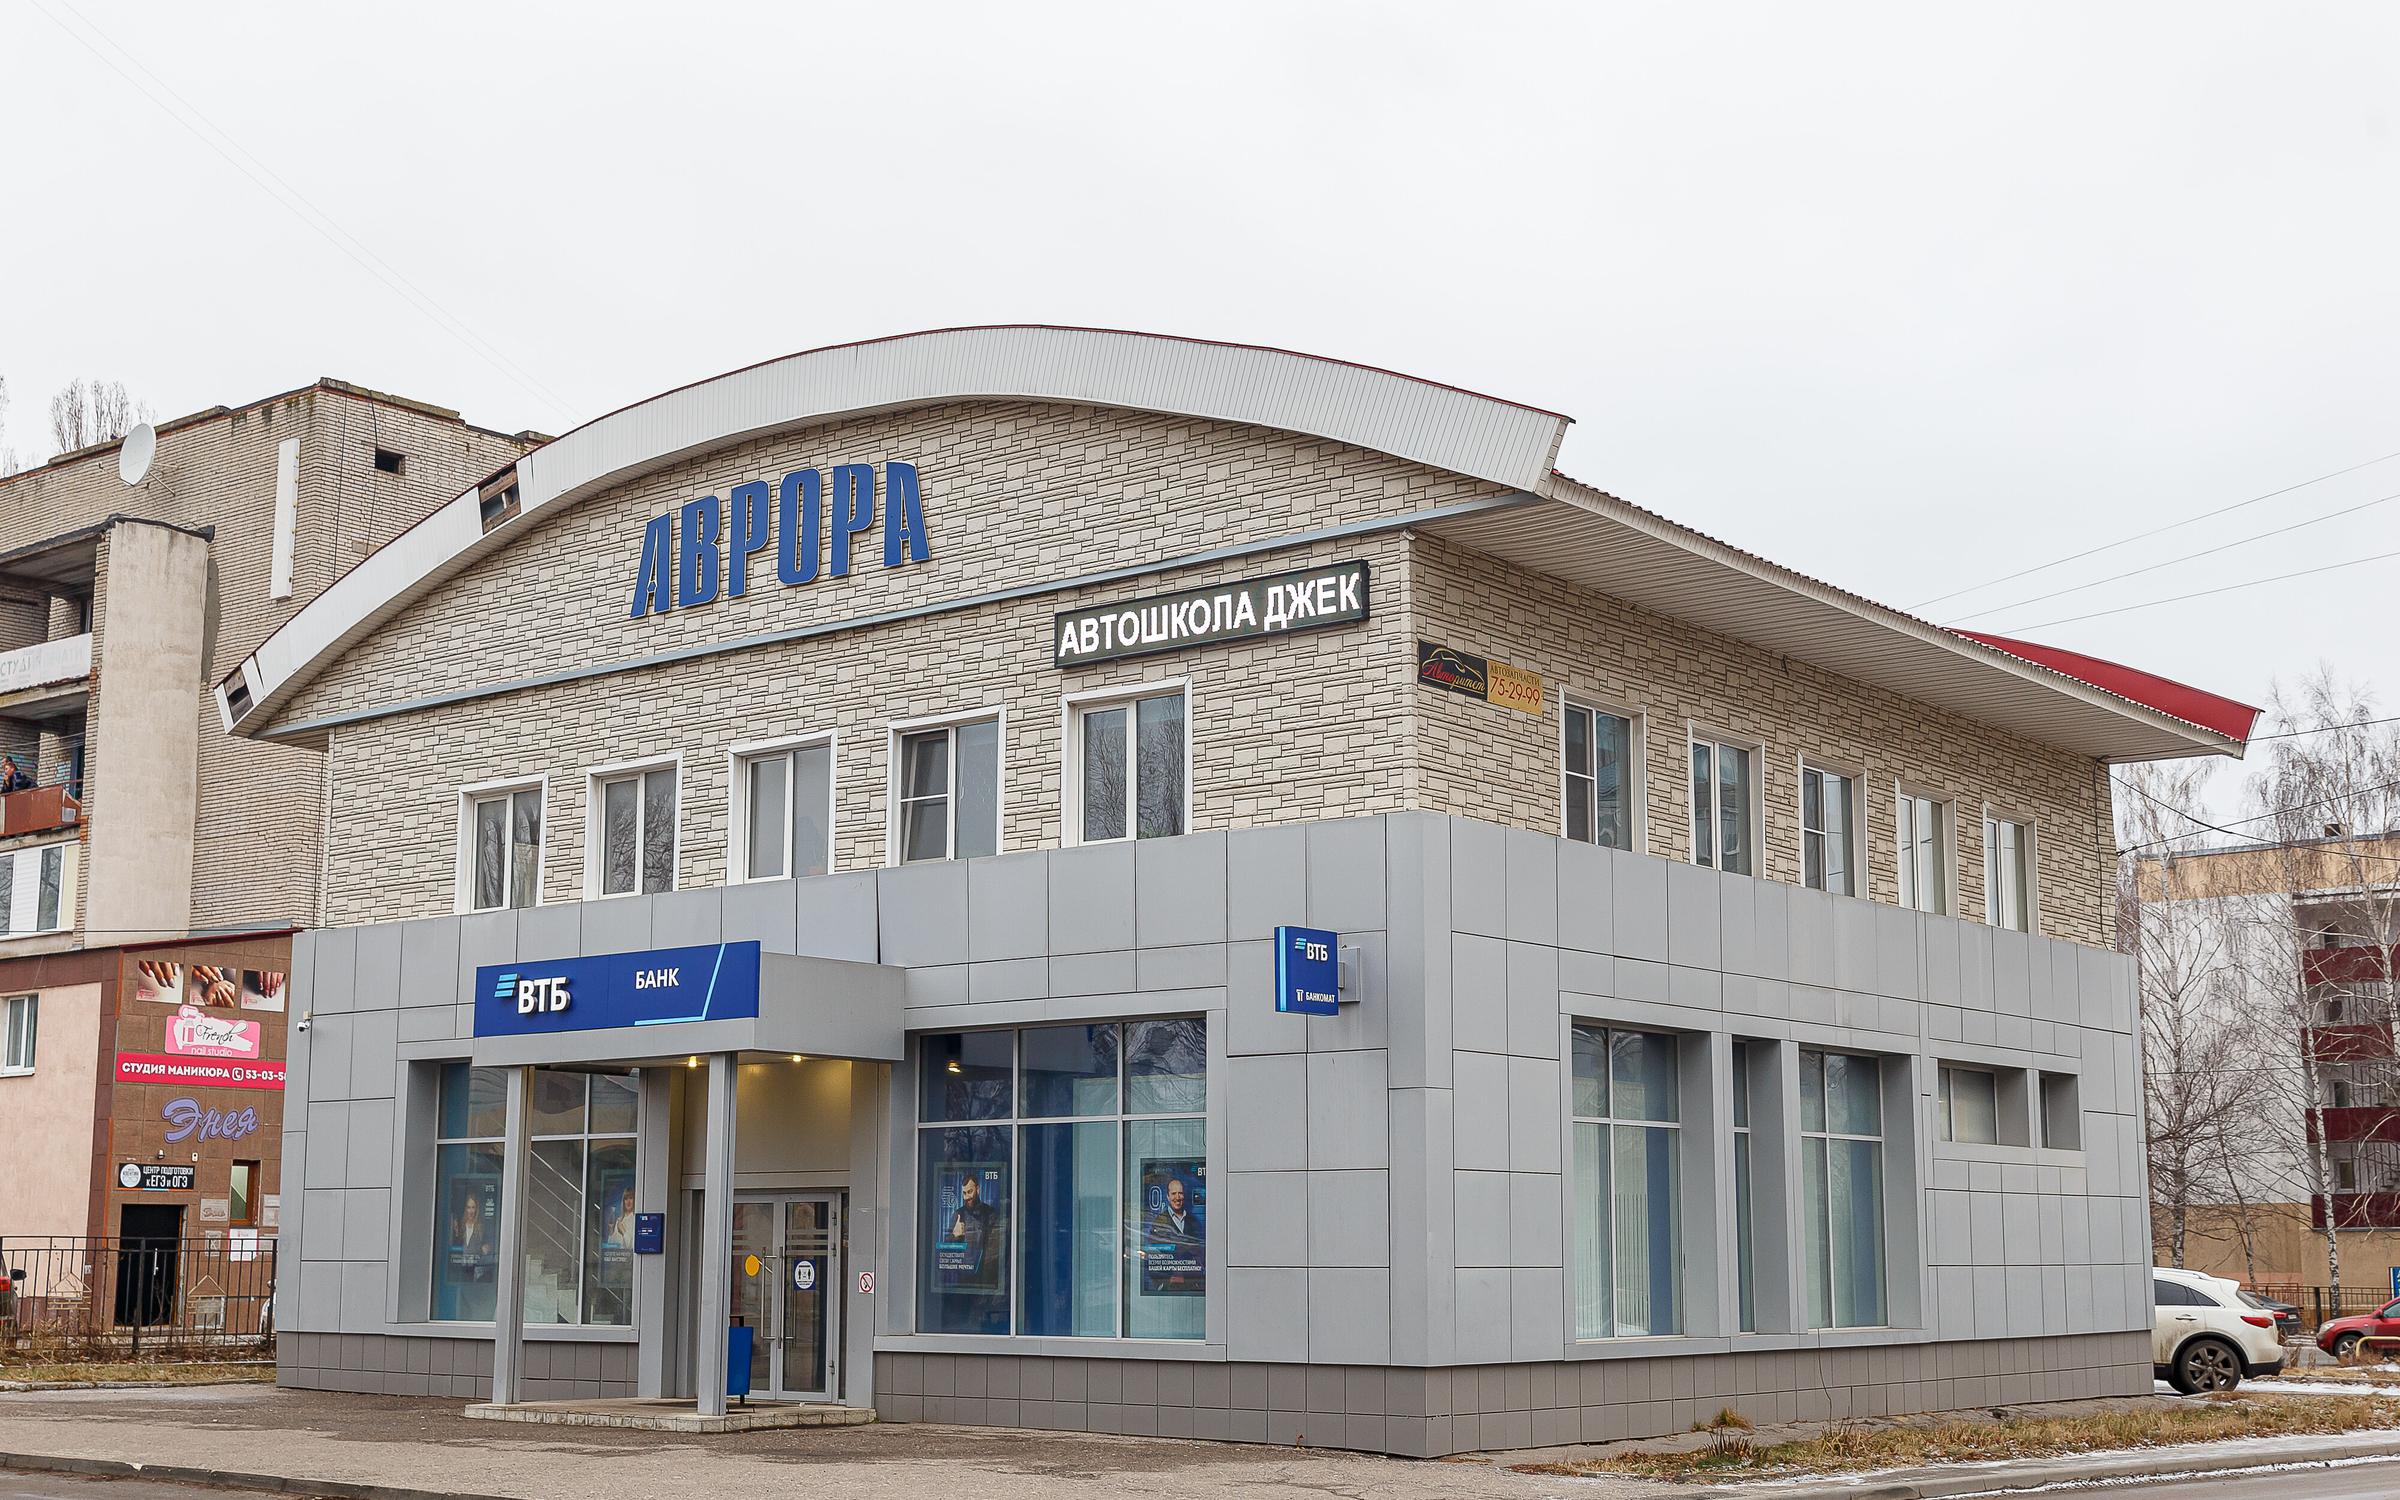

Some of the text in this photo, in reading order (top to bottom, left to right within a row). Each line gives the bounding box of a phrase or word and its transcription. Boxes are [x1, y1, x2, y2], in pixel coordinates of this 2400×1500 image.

[630, 460, 932, 618] АВРОРА
[1058, 572, 1360, 657] АВТОШКОЛА ДЖЕК
[1489, 665, 1540, 687] АВТОЗАПЧАСТИ
[1490, 675, 1540, 706] 75-29-99
[1306, 942, 1328, 961] ВТБ
[517, 968, 680, 1014] ВТБ БАНК
[1305, 991, 1336, 1003] БАНКОМАТ
[191, 1047, 233, 1057] nail studio
[122, 1062, 166, 1075] СТУДИЯ
[167, 1065, 230, 1078] МАНИКЮРА
[162, 1097, 259, 1144] Энея
[143, 1166, 194, 1176] ЦЕНТР ПОДГОТОВКИ
[985, 1171, 998, 1180] ВТБ
[151, 1175, 166, 1187] ЕГЭ
[172, 1175, 188, 1188] ОГЭ
